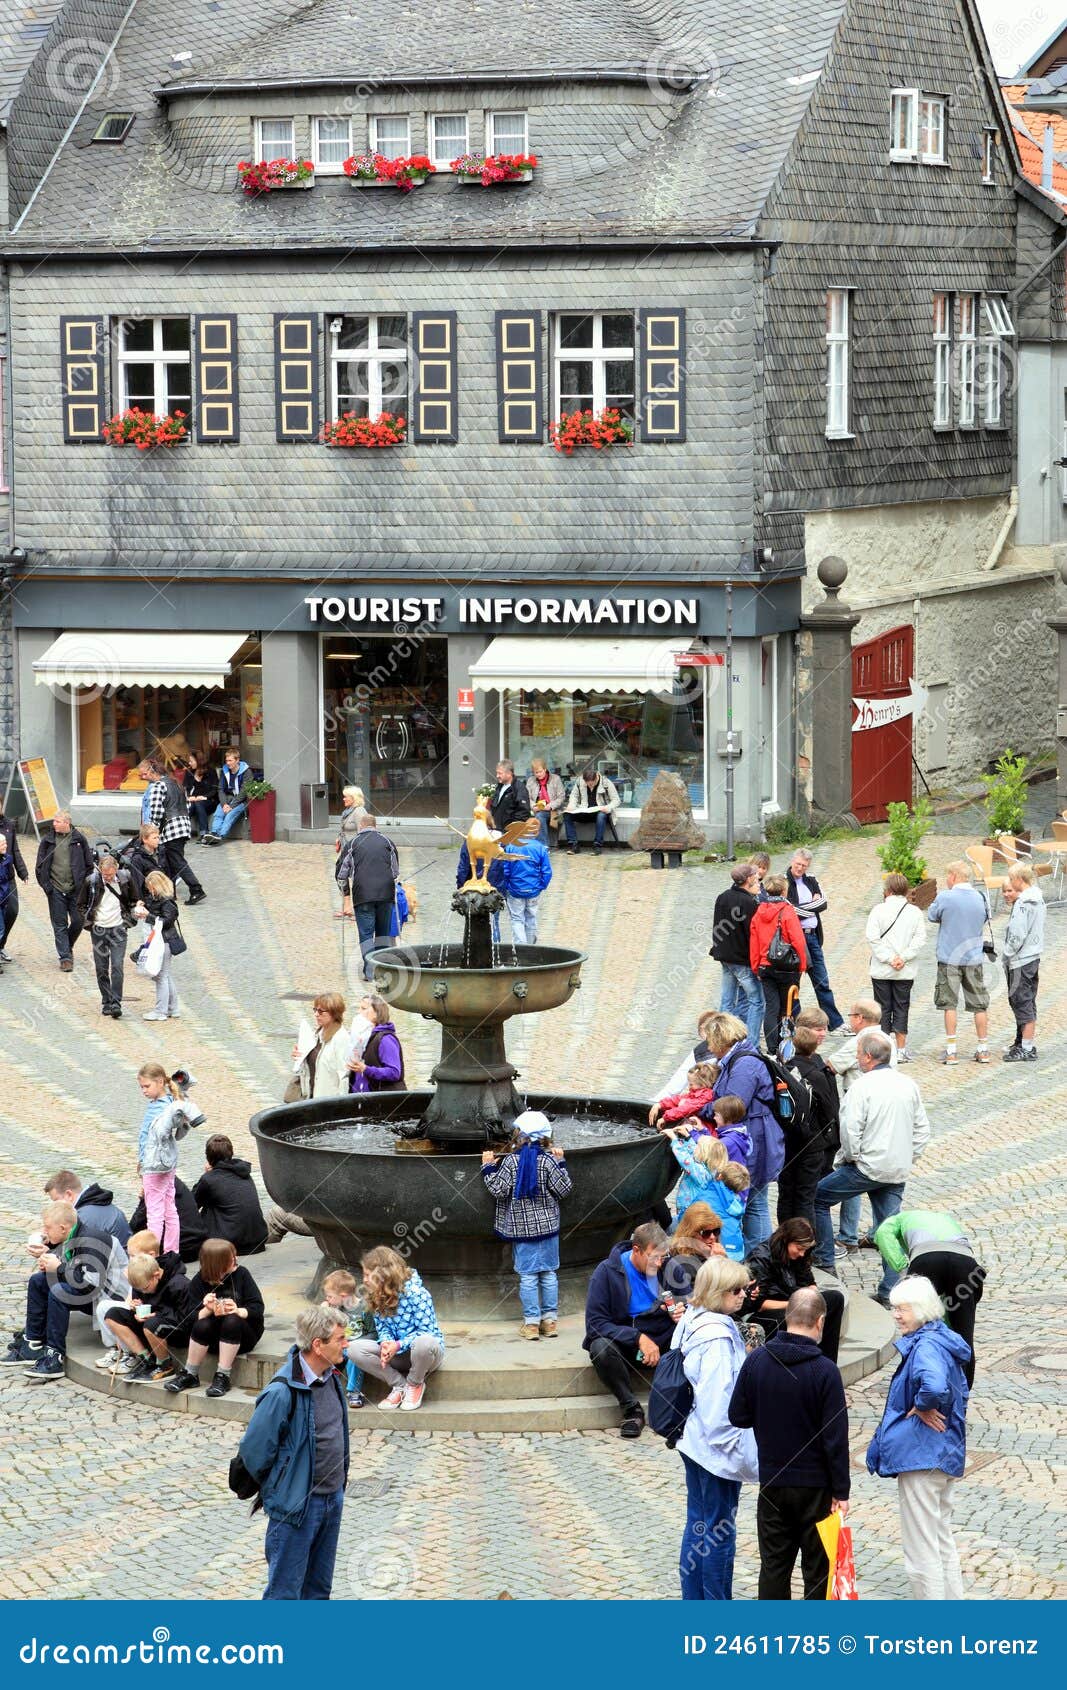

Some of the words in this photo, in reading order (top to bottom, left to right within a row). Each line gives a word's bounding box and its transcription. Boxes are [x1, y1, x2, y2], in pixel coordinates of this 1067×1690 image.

[305, 597, 441, 622] TOURIST
[459, 598, 697, 624] INFORMATION
[859, 700, 901, 728] Henry's
